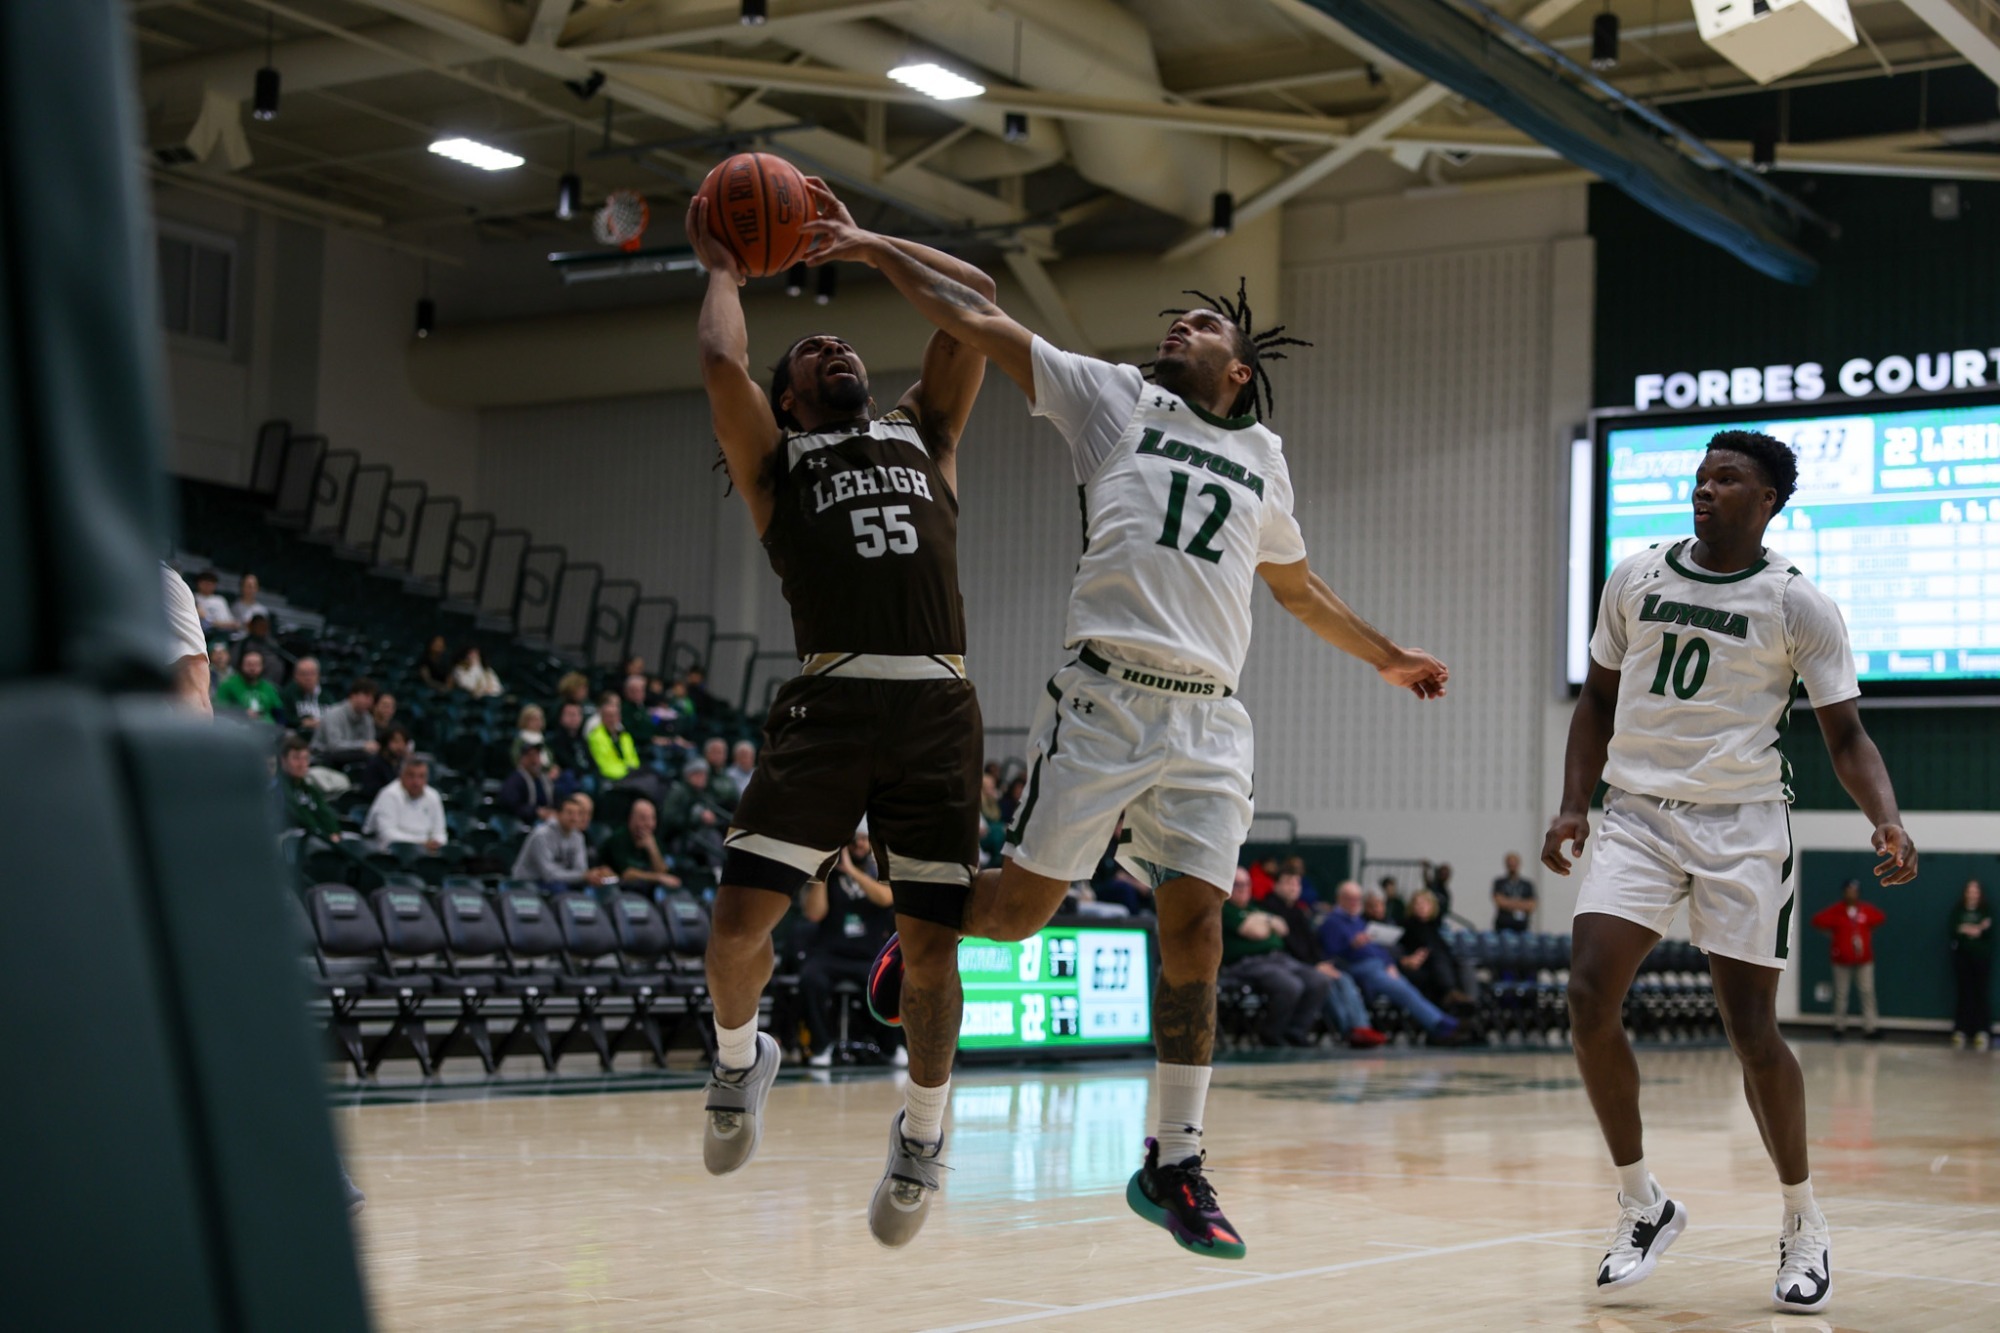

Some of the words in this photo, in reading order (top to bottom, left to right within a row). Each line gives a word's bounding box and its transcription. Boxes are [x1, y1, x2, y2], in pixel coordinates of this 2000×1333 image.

[731, 208, 759, 247] THE
[1634, 361, 1827, 411] FORBES
[1136, 426, 1265, 502] LOYOLA
[812, 465, 934, 514] LEHIGH
[849, 504, 919, 559] 55
[1155, 469, 1233, 565] 12
[1639, 593, 1749, 639] LOYOLA
[1121, 668, 1216, 696] HOUNDS
[1648, 631, 1711, 700] 10
